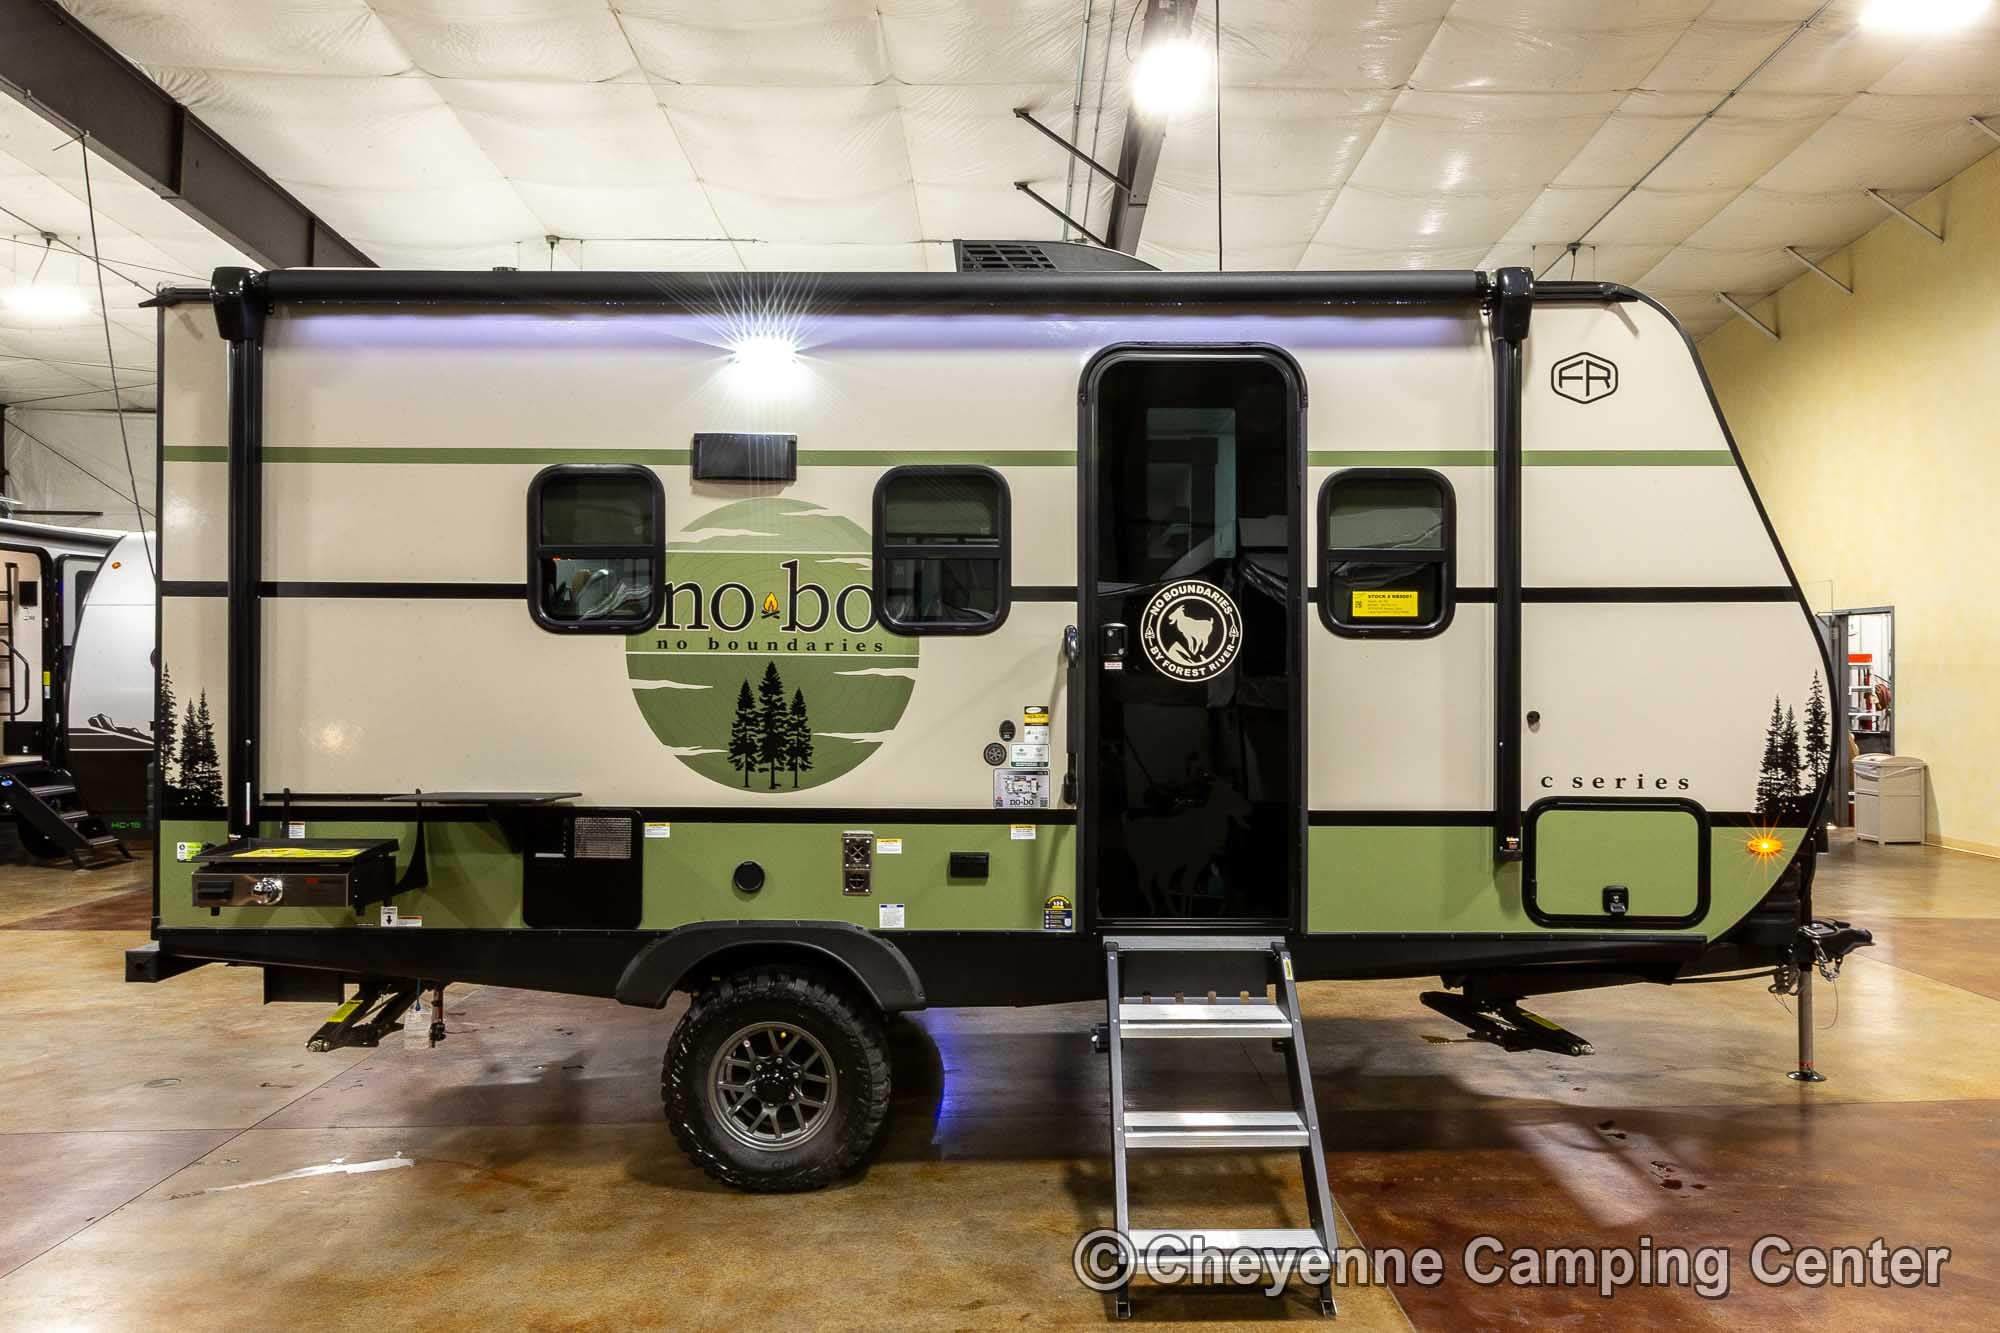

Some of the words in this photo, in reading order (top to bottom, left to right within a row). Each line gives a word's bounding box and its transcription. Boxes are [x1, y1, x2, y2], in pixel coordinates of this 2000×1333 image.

[1149, 599, 1165, 616] NO
[1162, 584, 1233, 615] BOUNDARIES
[656, 638, 688, 650] no
[708, 637, 884, 652] boundaries
[1150, 645, 1165, 661] BY
[1161, 660, 1206, 677] FOREST
[1208, 644, 1235, 672] RIVER
[1540, 775, 1553, 789] c
[1571, 773, 1690, 790] series
